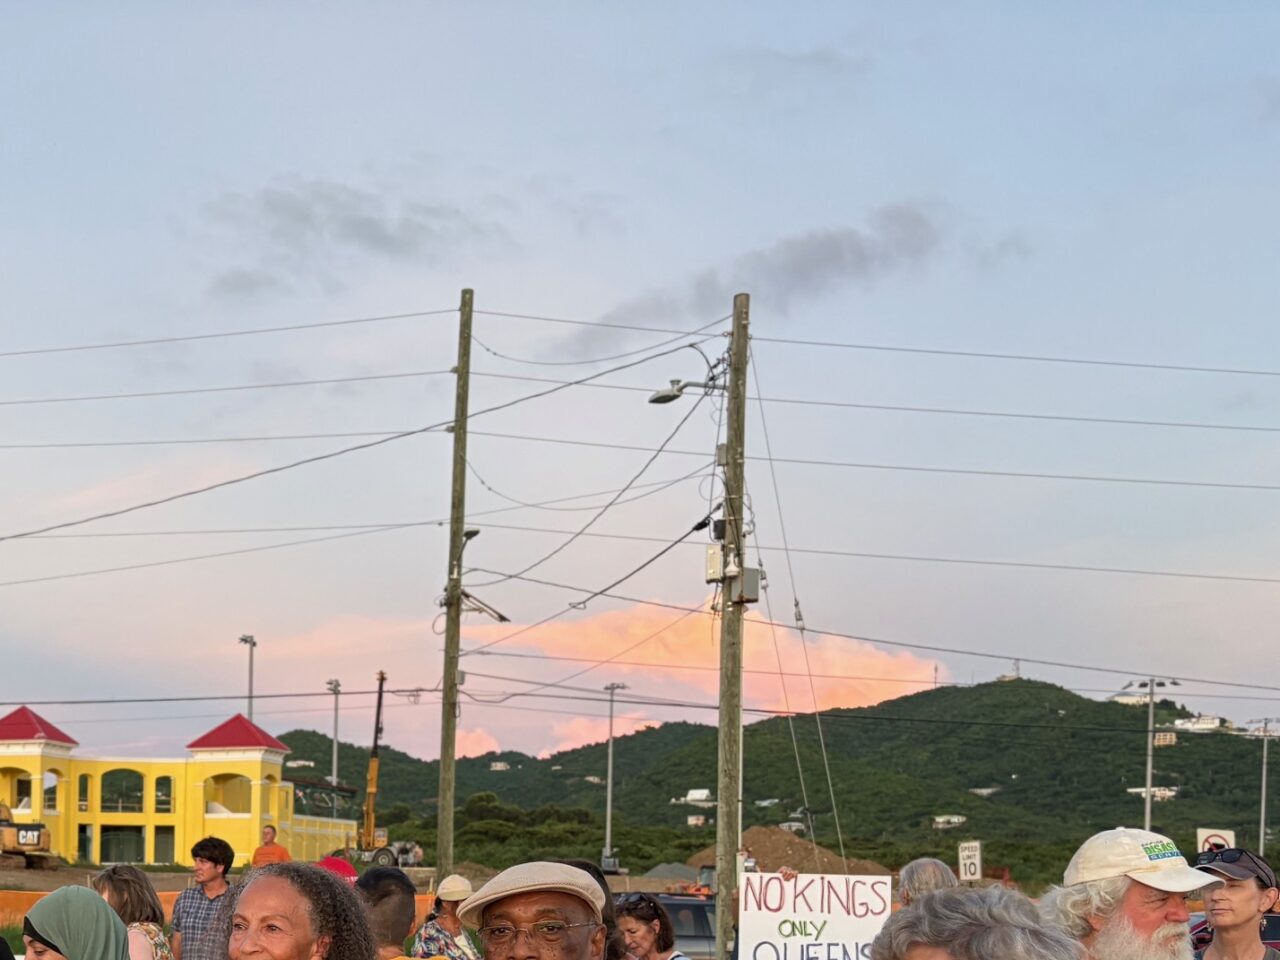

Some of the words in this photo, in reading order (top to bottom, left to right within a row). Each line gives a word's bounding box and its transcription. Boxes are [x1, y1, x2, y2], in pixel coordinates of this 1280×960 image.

[18, 829, 40, 844] CAT
[963, 862, 977, 876] 10
[743, 876, 785, 913] NO
[792, 876, 888, 918] KINGS
[778, 919, 828, 942] ONLY
